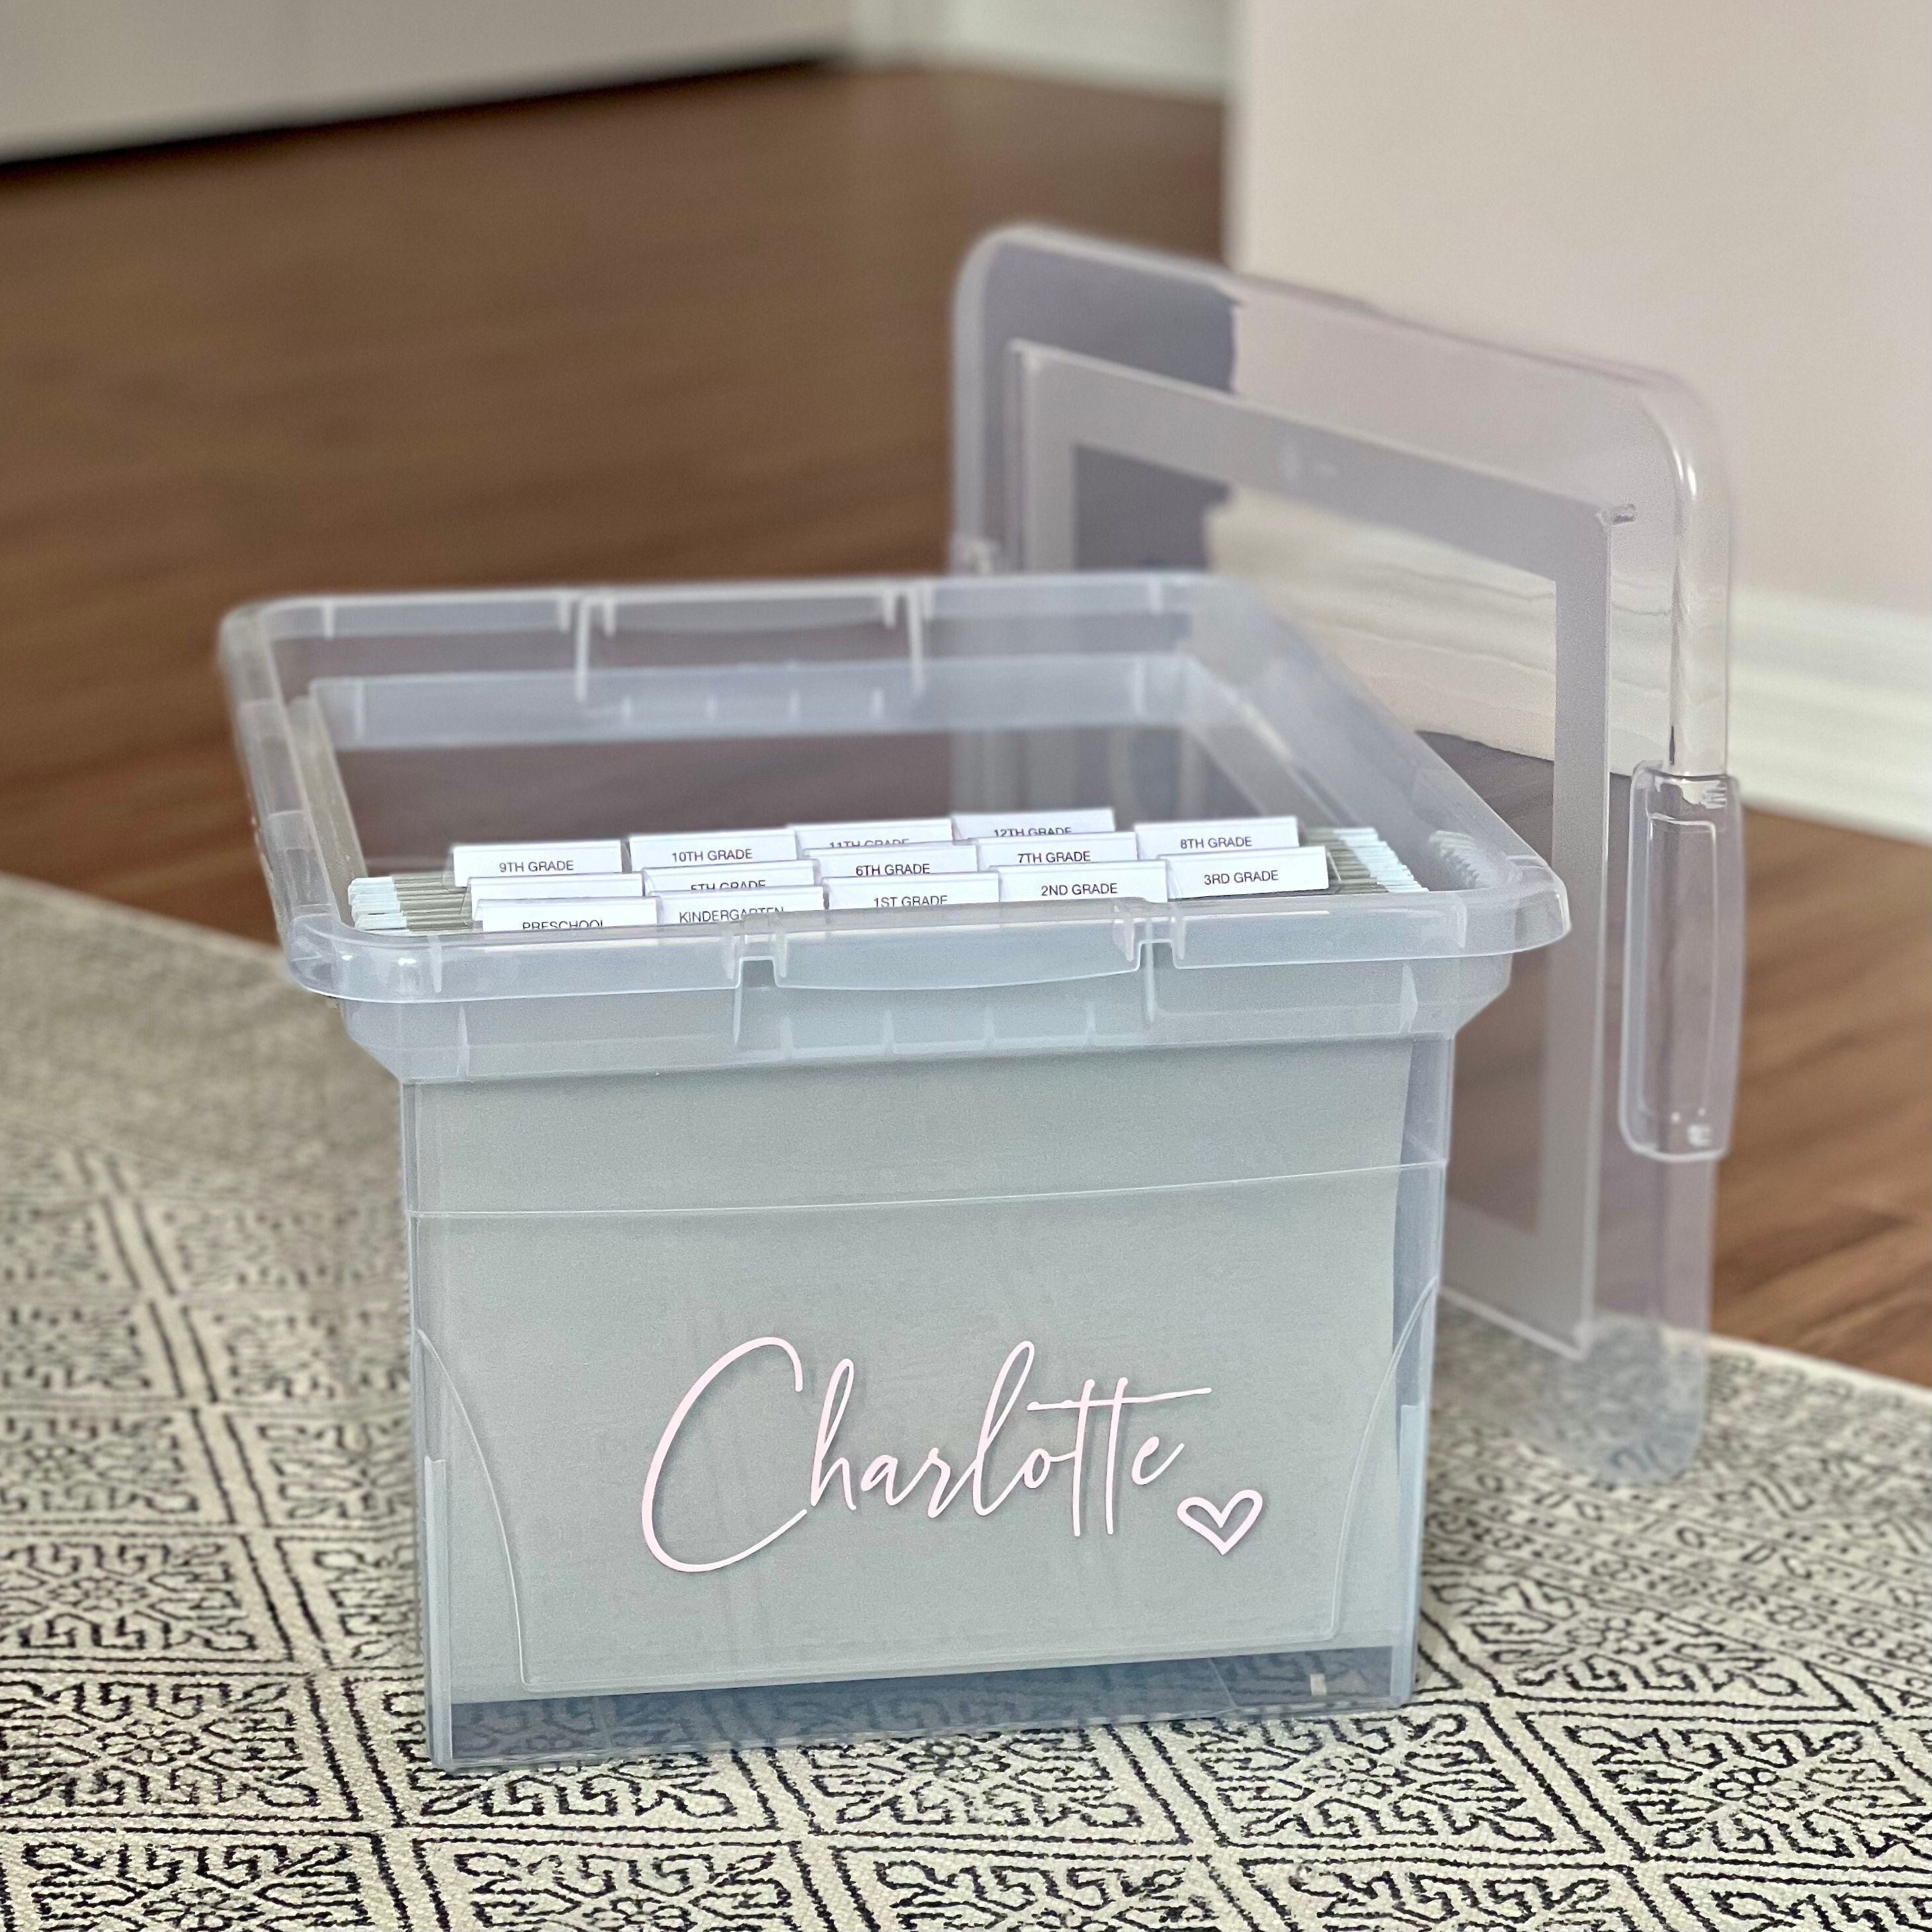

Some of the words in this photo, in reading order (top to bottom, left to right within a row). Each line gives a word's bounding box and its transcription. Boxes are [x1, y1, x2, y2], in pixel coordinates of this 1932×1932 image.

[1180, 839, 1204, 849] 8TH
[1208, 836, 1253, 848] GRADE
[671, 851, 704, 862] 10TH
[707, 849, 753, 861] GRADE
[1017, 853, 1042, 864] 7TH
[1046, 851, 1091, 863] GRADE
[499, 862, 524, 873] 9TH
[528, 860, 574, 872] GRADE
[856, 864, 880, 876] 6TH
[884, 863, 930, 875] GRADE
[1204, 873, 1230, 886] 3RD
[1234, 870, 1279, 884] GRADE
[1040, 884, 1068, 896] 2ND
[1071, 882, 1118, 896] GRADE
[873, 897, 898, 908] 1ST
[901, 895, 948, 907] GRADE
[642, 1336, 1212, 1573] Charlotte
